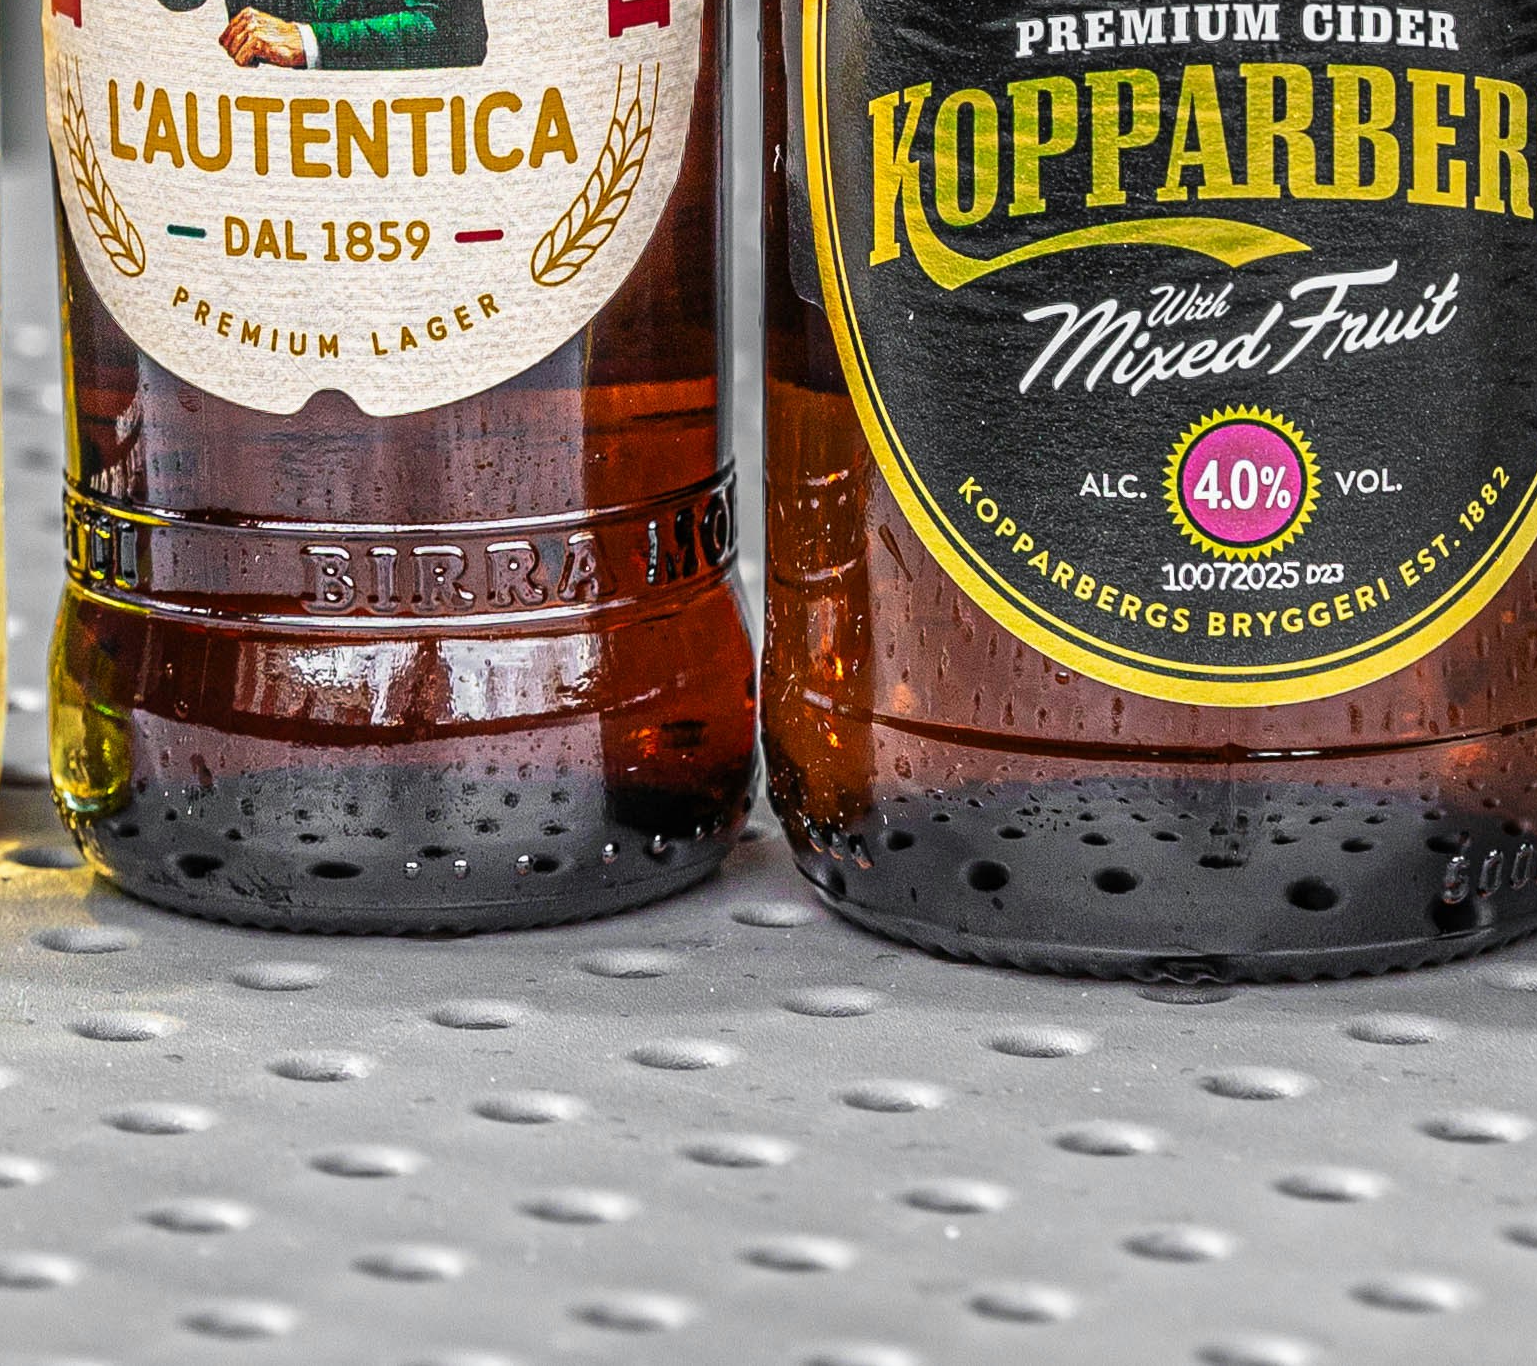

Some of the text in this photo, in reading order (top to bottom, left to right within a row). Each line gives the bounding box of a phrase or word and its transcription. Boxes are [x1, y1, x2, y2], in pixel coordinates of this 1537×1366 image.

[1014, 2, 1459, 59] PREMIUM CIDER
[107, 78, 578, 179] L'AUTENTICA
[223, 215, 430, 263] DAL 1859
[172, 284, 504, 360] PREMIUM LAGER
[1018, 259, 1459, 397] Mixed Fruit
[1148, 283, 1229, 329] With
[1078, 459, 1403, 512] ALC. 4.0% VOL.
[299, 529, 616, 615] BIRRA
[955, 466, 1513, 638] KOPPARBERGS BRYGGERI EST. 1882
[1160, 560, 1345, 592] 10072025 D23
